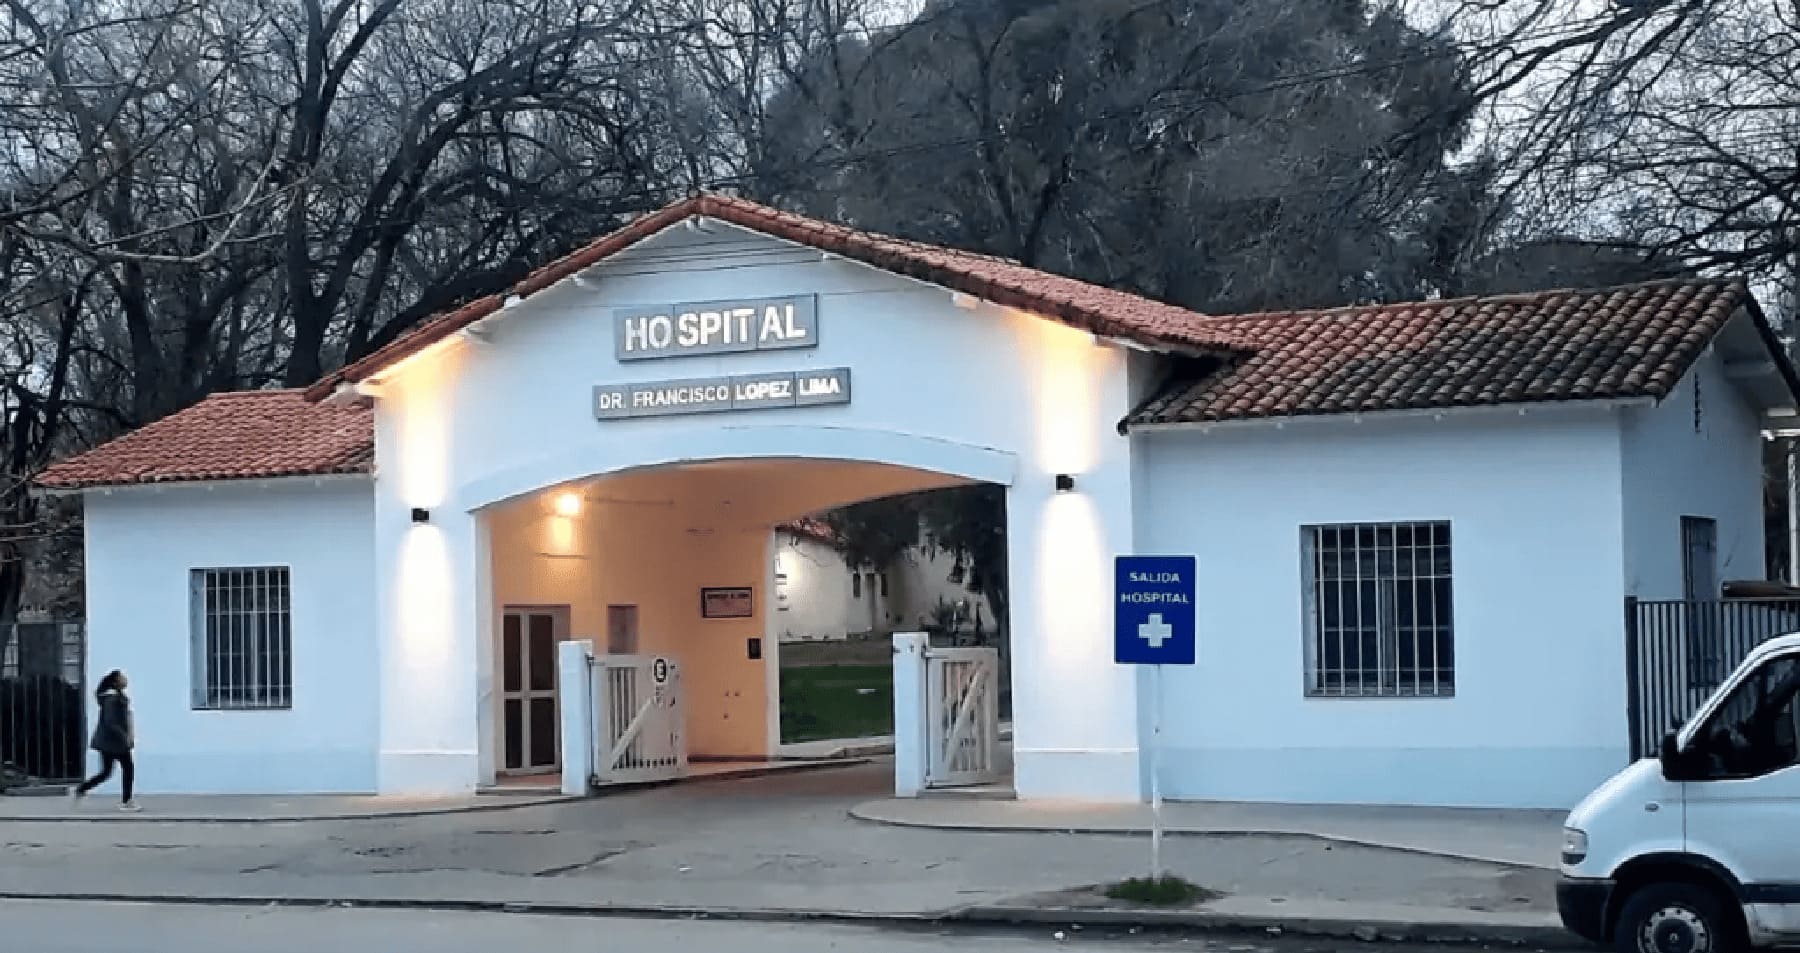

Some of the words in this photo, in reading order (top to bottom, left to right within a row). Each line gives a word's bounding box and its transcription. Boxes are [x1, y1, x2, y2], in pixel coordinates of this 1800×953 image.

[624, 304, 806, 351] HOSPITAL
[600, 392, 626, 409] DR.
[633, 385, 729, 408] FRANCISCO
[736, 380, 792, 401] LOPEZ
[799, 377, 841, 394] LIMA
[1129, 571, 1181, 583] SALIDA
[1121, 592, 1189, 604] HOSPITAL
